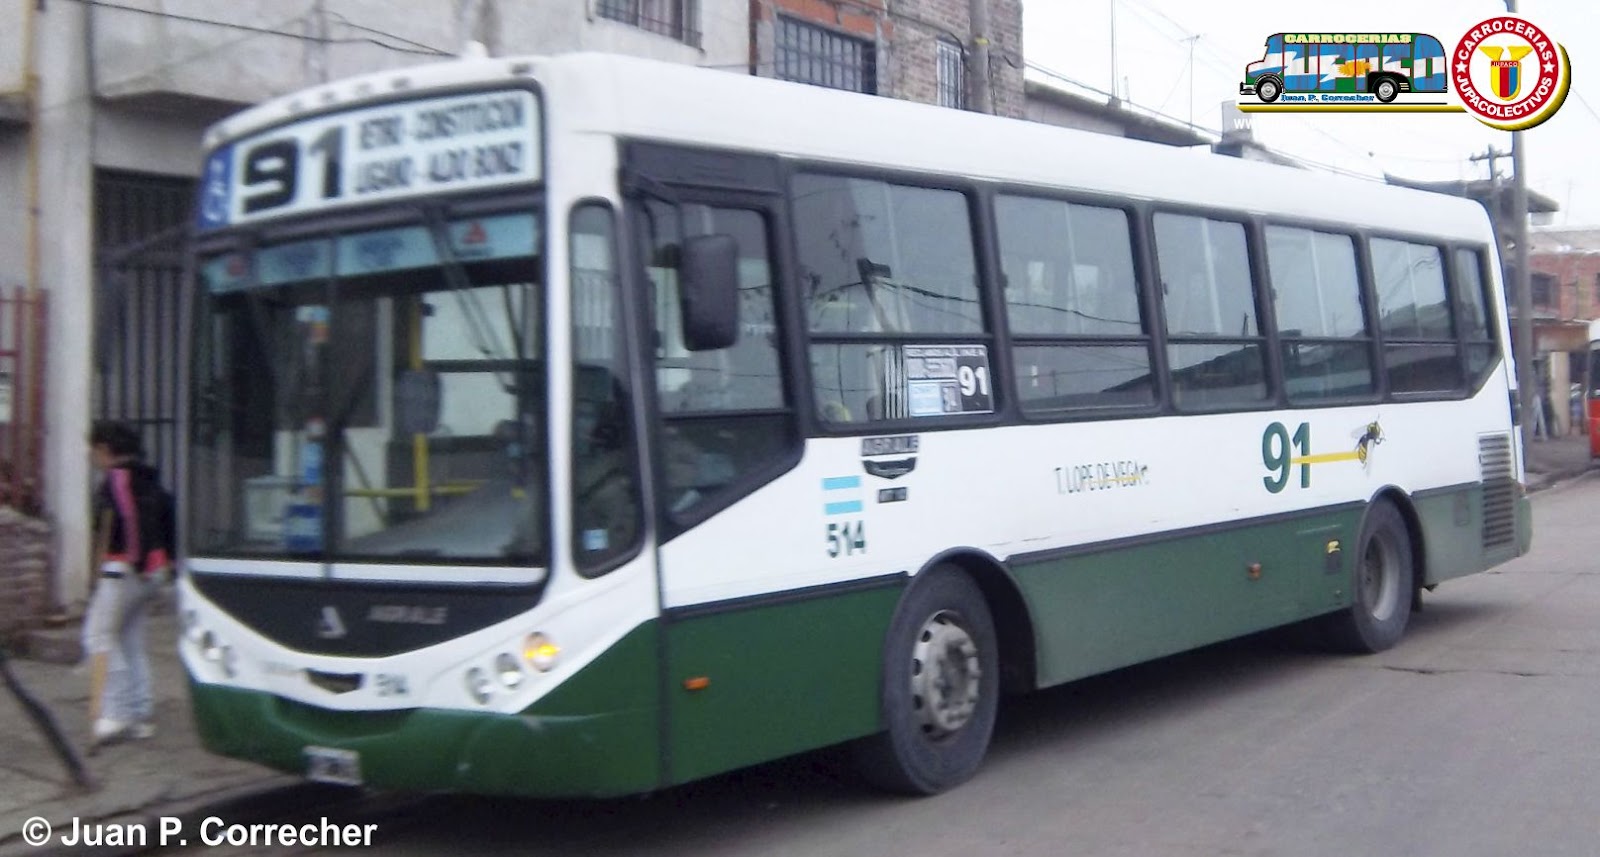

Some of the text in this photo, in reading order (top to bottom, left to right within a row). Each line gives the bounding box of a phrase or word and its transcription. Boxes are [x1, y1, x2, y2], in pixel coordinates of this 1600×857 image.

[243, 125, 343, 216] 91
[957, 365, 988, 397] 91
[1065, 464, 1095, 493] LOPE
[1096, 462, 1112, 490] DE
[1112, 460, 1142, 488] VEGA
[1262, 421, 1311, 494] 91
[825, 520, 866, 558] 514
